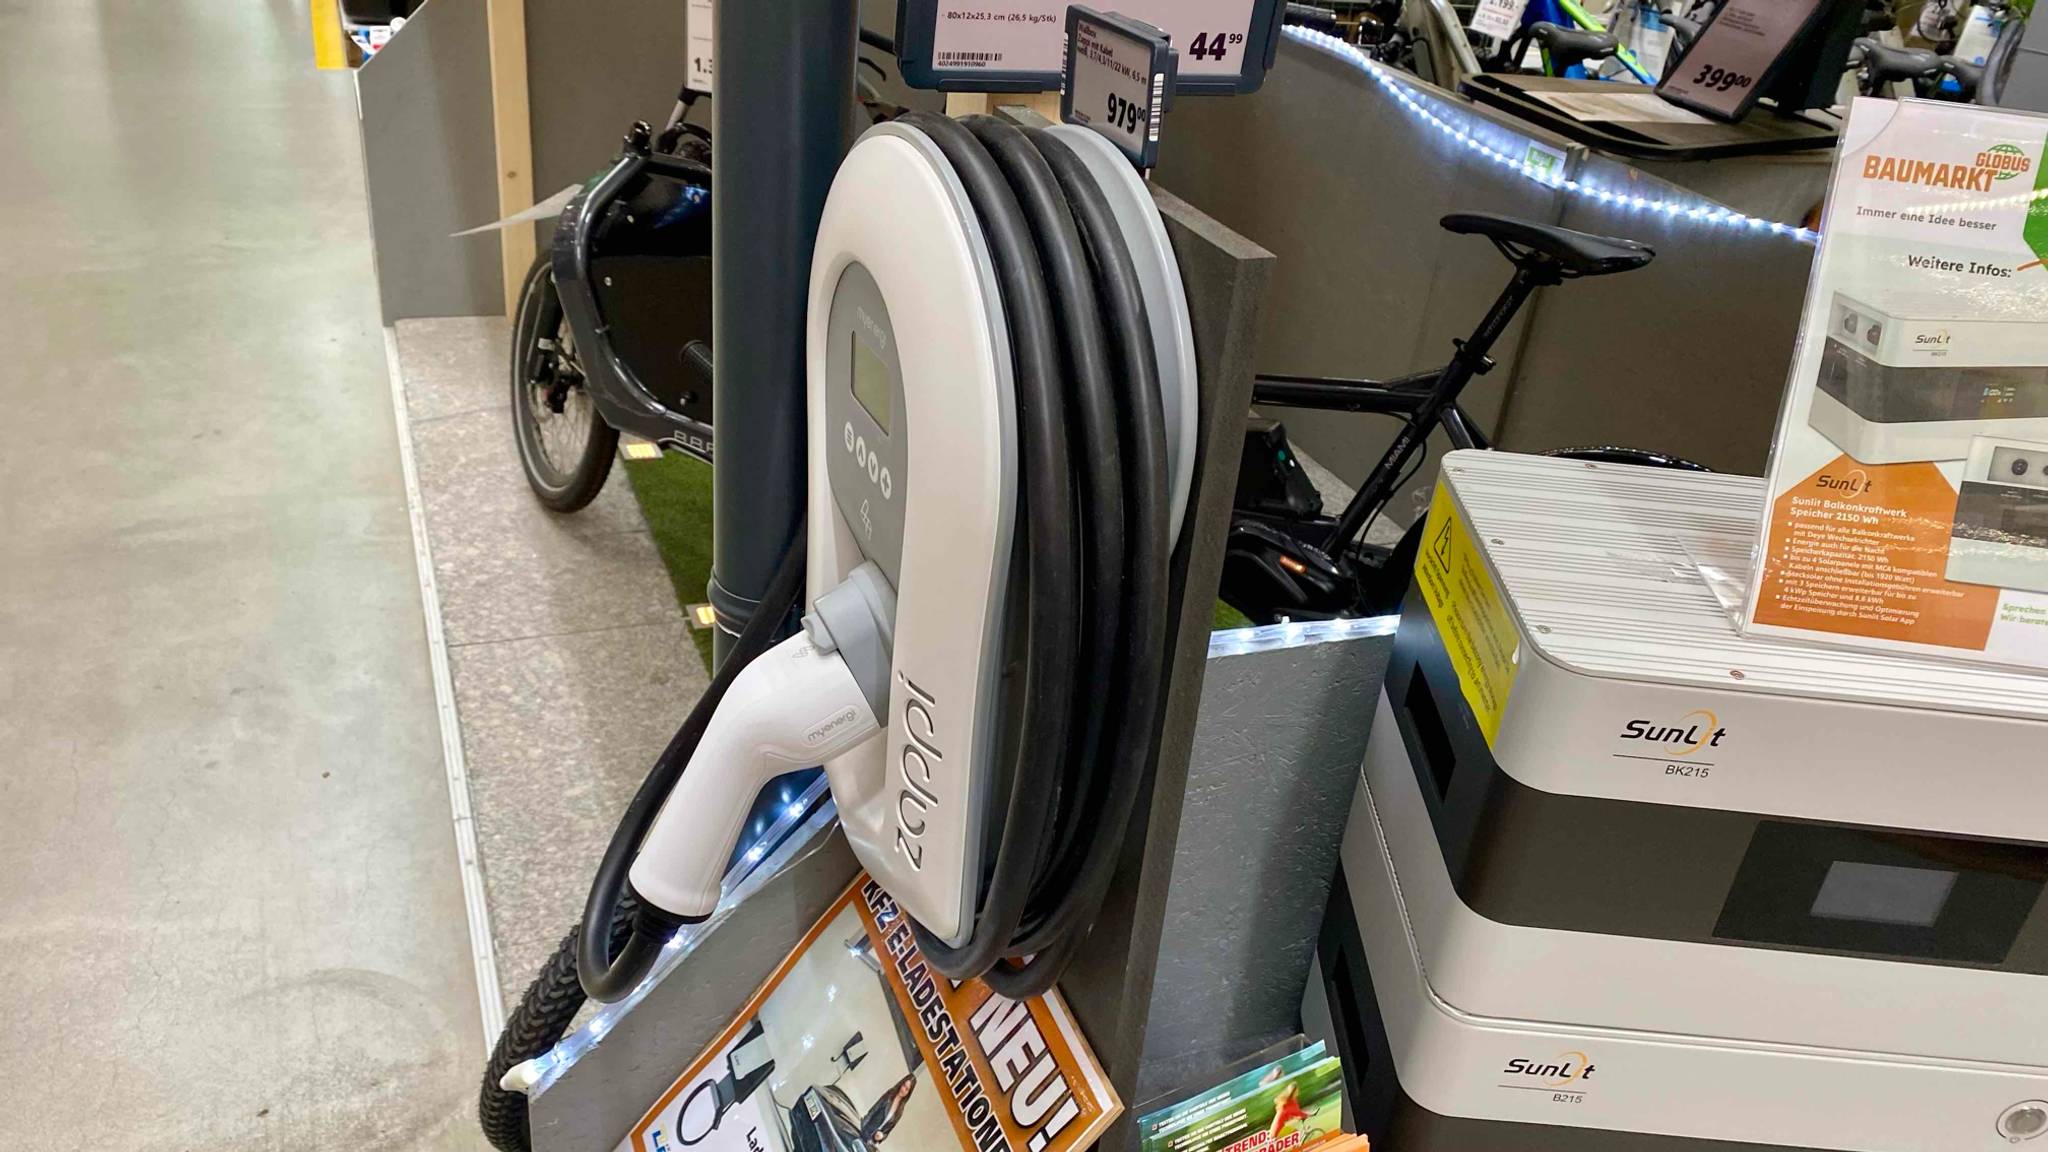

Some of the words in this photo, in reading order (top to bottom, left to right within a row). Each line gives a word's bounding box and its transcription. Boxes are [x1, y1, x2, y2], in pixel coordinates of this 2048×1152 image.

[1008, 13, 1026, 22] (26,5
[1029, 14, 1057, 24] kg/Stk)
[1975, 151, 2031, 172] GLOBUS
[1862, 154, 1998, 193] BAUMARKT
[1856, 206, 1897, 220] Immer
[1899, 212, 1925, 223] eine
[1928, 213, 1956, 227] Idee
[1958, 217, 1997, 231] besser
[1908, 254, 1964, 273] Weitere
[1968, 260, 2013, 279] Infos:
[1384, 436, 1410, 470] MIAMI
[1790, 507, 1835, 520] Speicher
[1836, 512, 1860, 522] 2150
[1862, 515, 1879, 525] Wh
[1792, 496, 1821, 506] Sunlit
[1823, 499, 1908, 518] Balkonkraftwerk
[1793, 538, 1820, 548] Energie
[1820, 541, 1838, 549] auch
[1665, 764, 1710, 778] BK215
[968, 992, 1081, 1152] NEU!
[1552, 1093, 1582, 1104] B215
